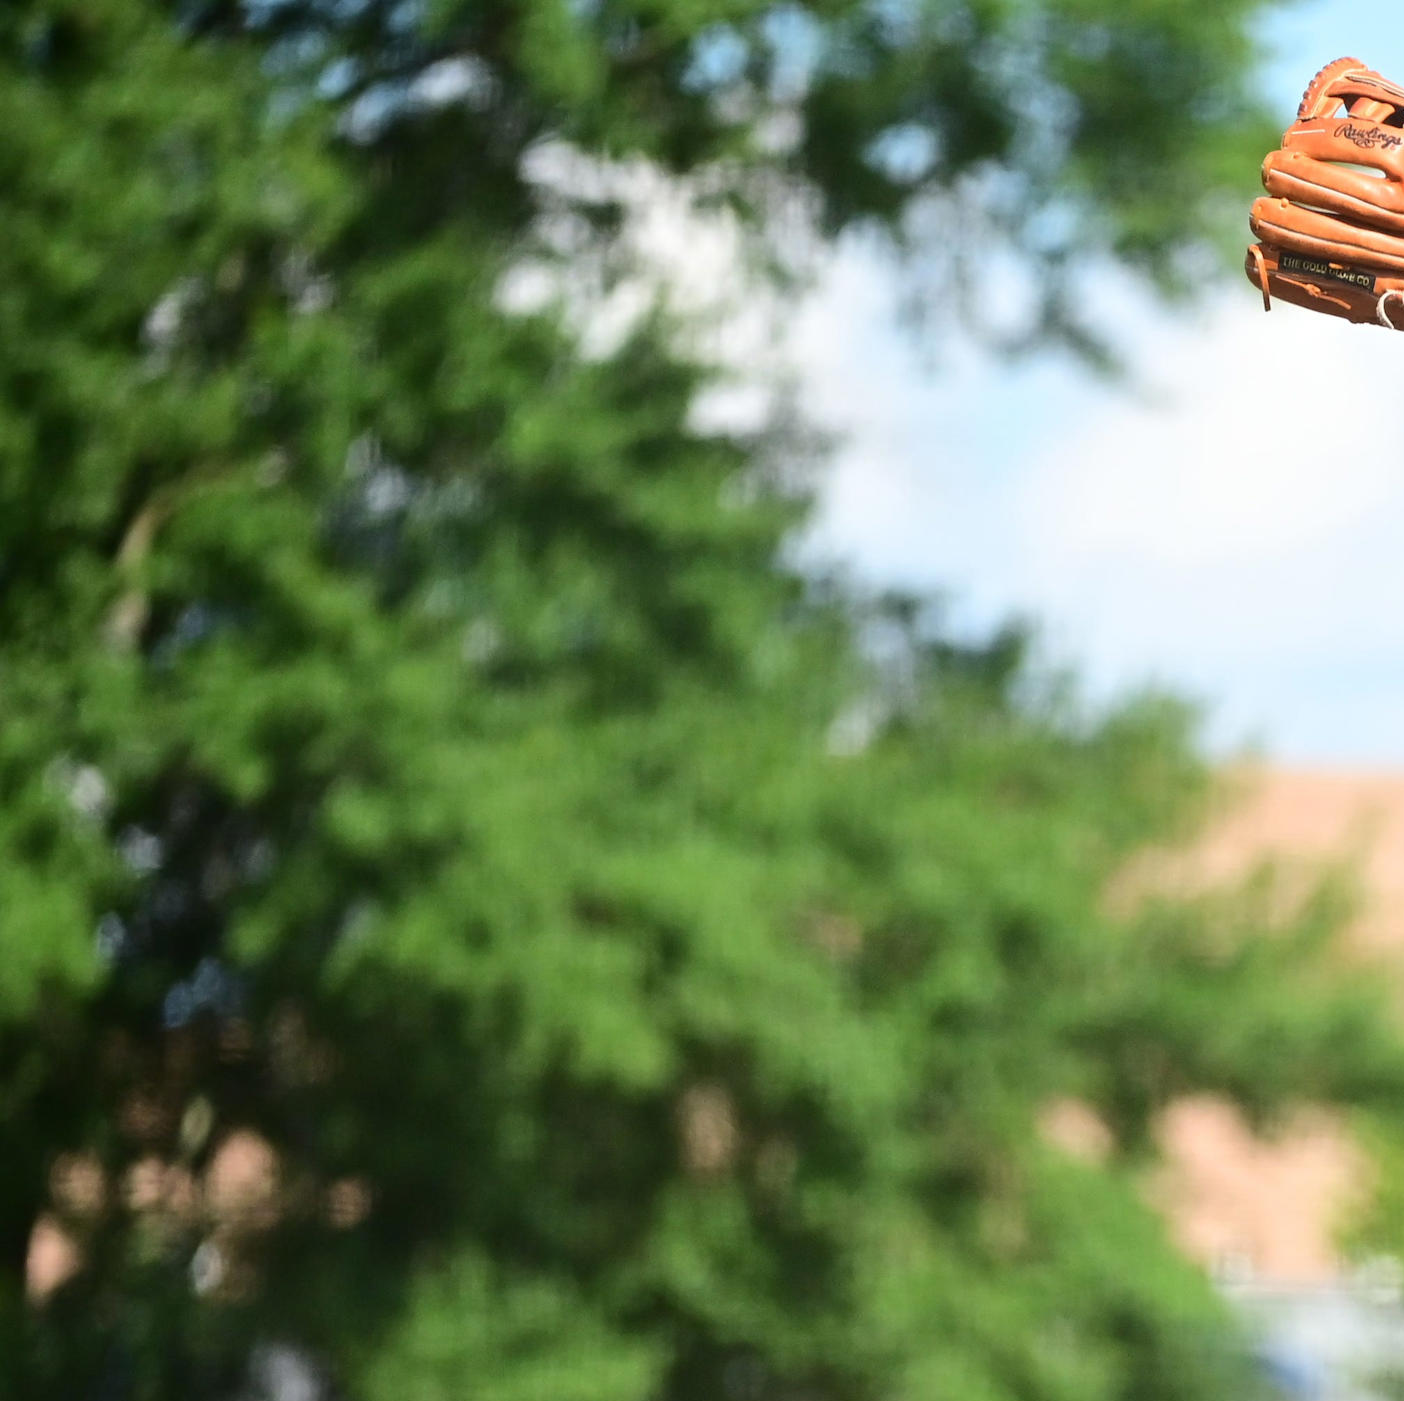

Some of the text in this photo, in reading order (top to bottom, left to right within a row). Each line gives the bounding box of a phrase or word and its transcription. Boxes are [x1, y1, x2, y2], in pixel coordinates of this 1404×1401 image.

[1334, 123, 1402, 149] Rawlings
[1283, 257, 1300, 269] THE
[1302, 260, 1328, 274] GOLD
